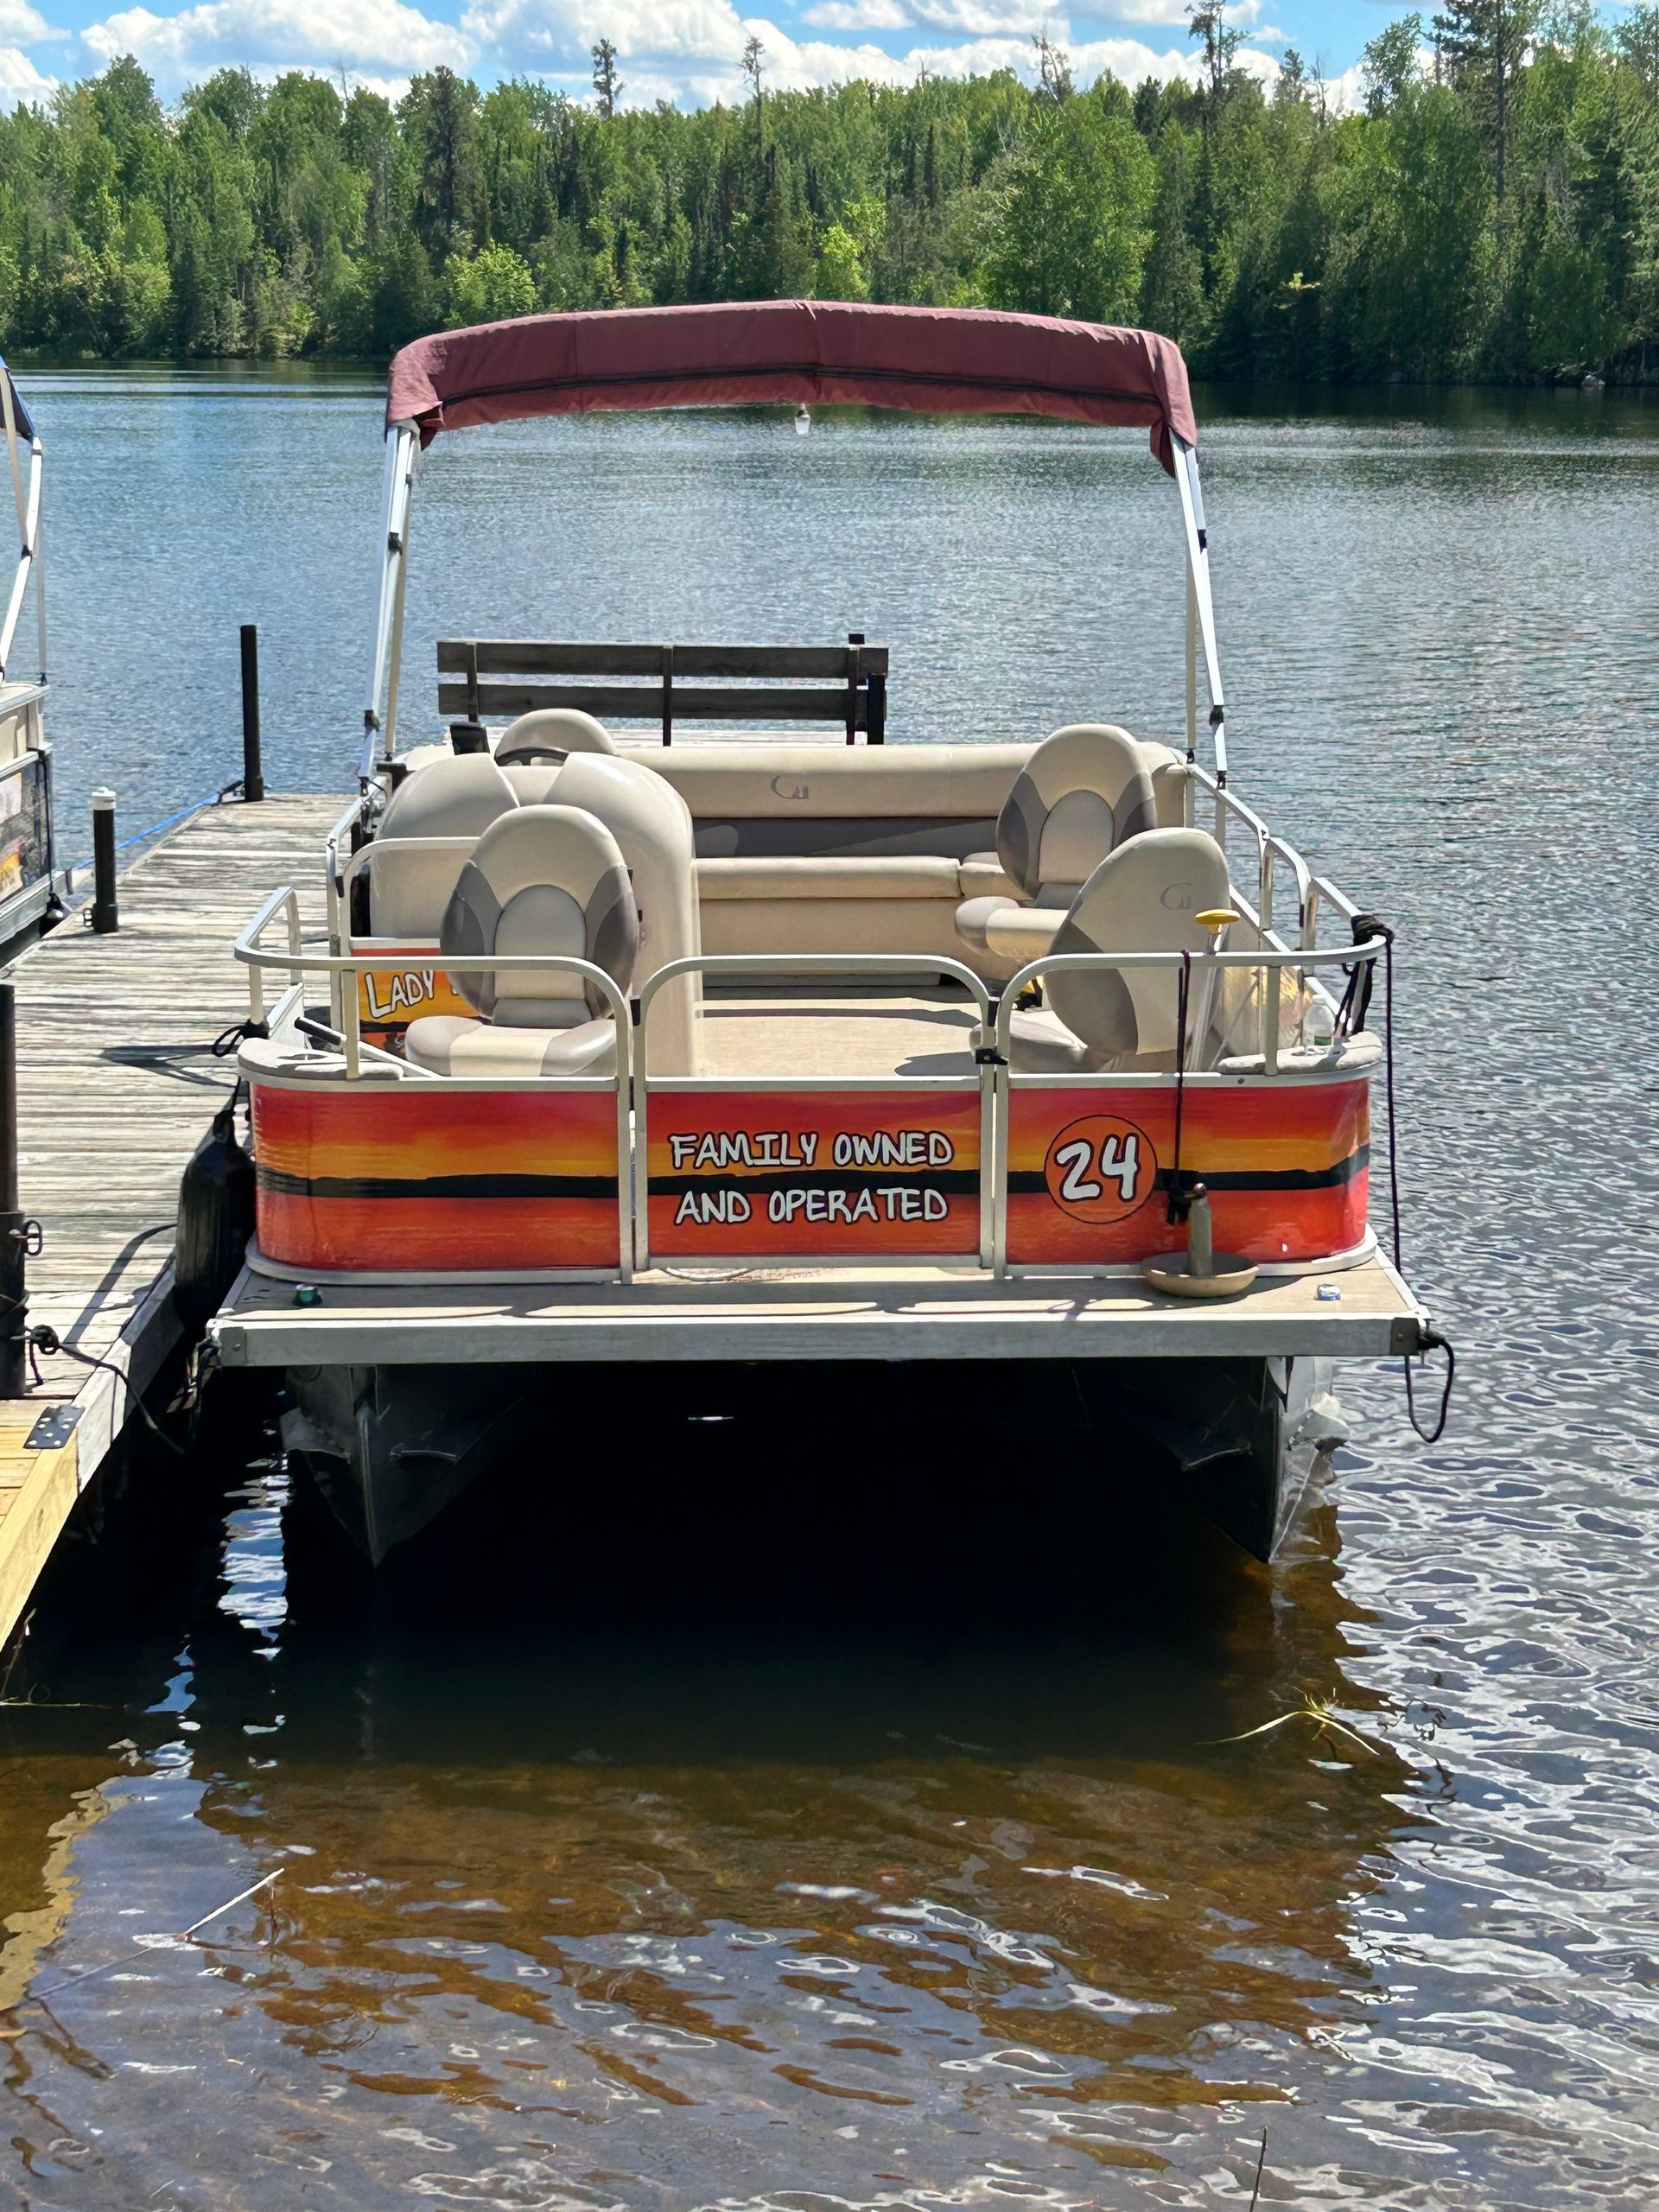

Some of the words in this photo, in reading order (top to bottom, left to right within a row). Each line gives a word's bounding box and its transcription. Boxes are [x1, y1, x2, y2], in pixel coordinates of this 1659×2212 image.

[365, 969, 434, 1019] LADY
[668, 1132, 819, 1168] FAMILY
[833, 1131, 955, 1166] OWNED
[1054, 1133, 1141, 1202] 24
[674, 1189, 752, 1224] AND
[767, 1185, 949, 1224] OPERATED
